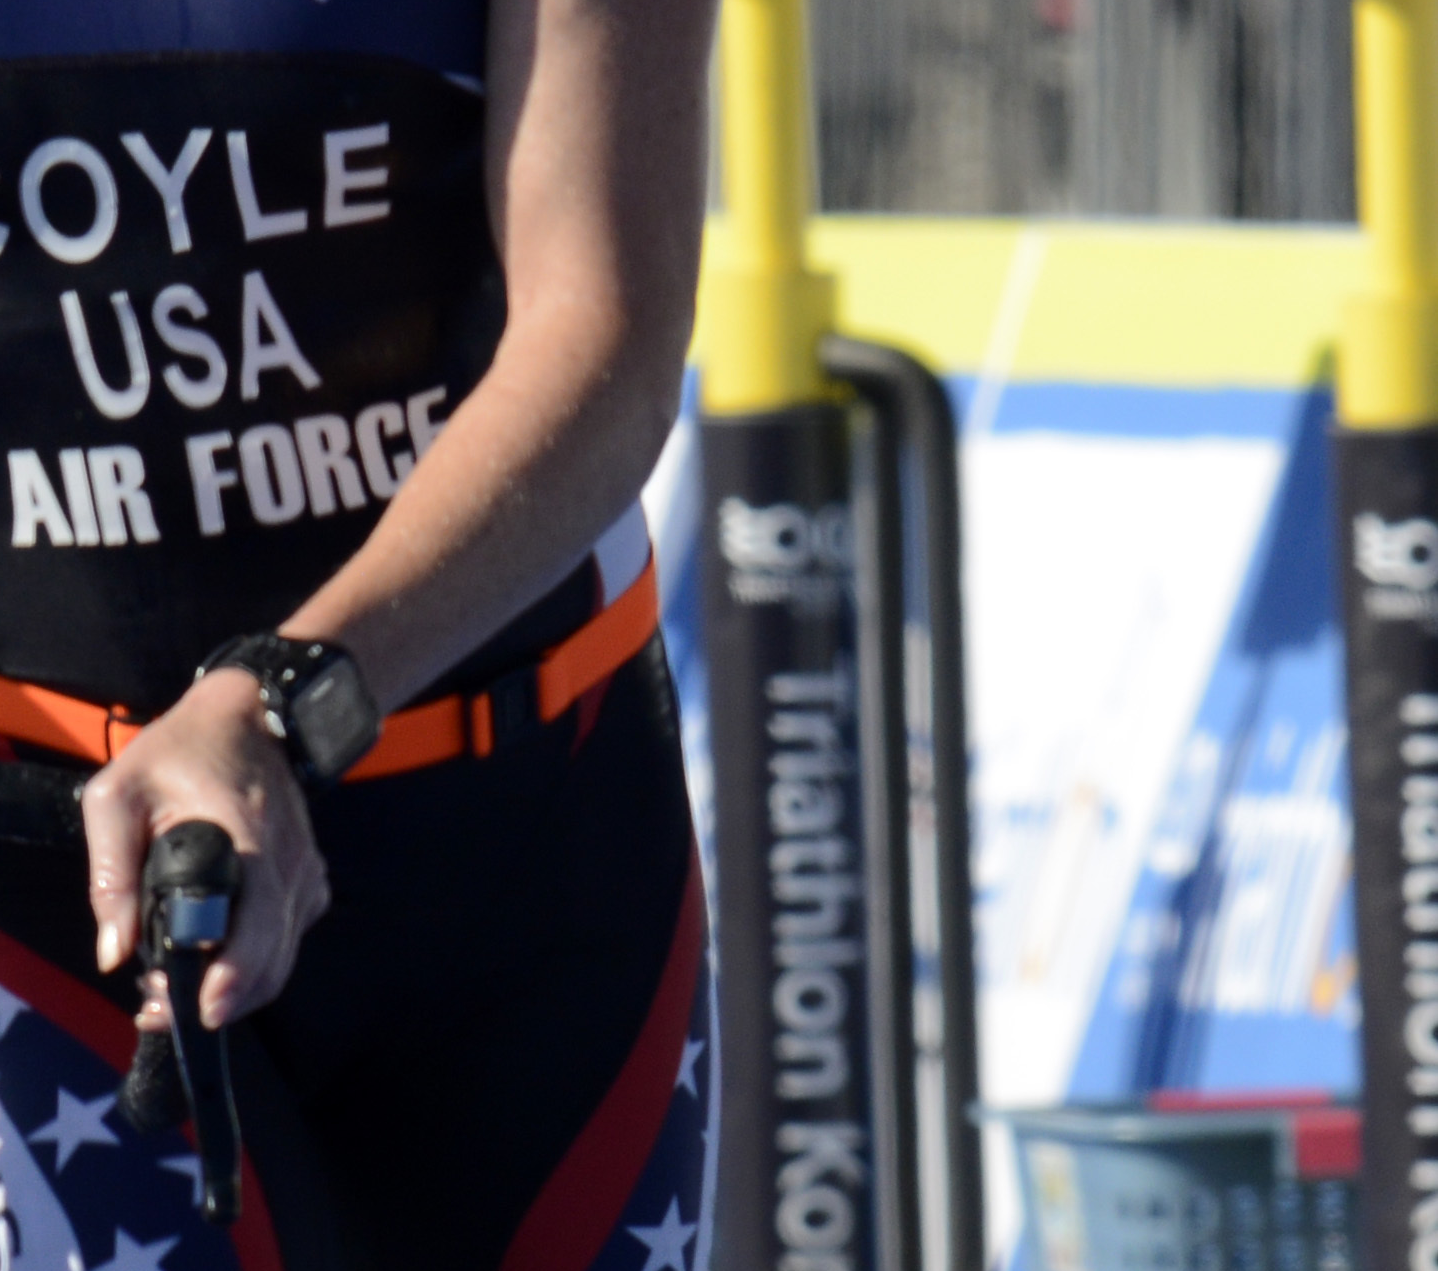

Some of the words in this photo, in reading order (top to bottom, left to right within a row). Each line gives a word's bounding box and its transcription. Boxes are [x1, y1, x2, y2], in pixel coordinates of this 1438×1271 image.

[60, 270, 321, 420] USA
[7, 445, 162, 548] AIR
[766, 654, 861, 1100] Triathlon
